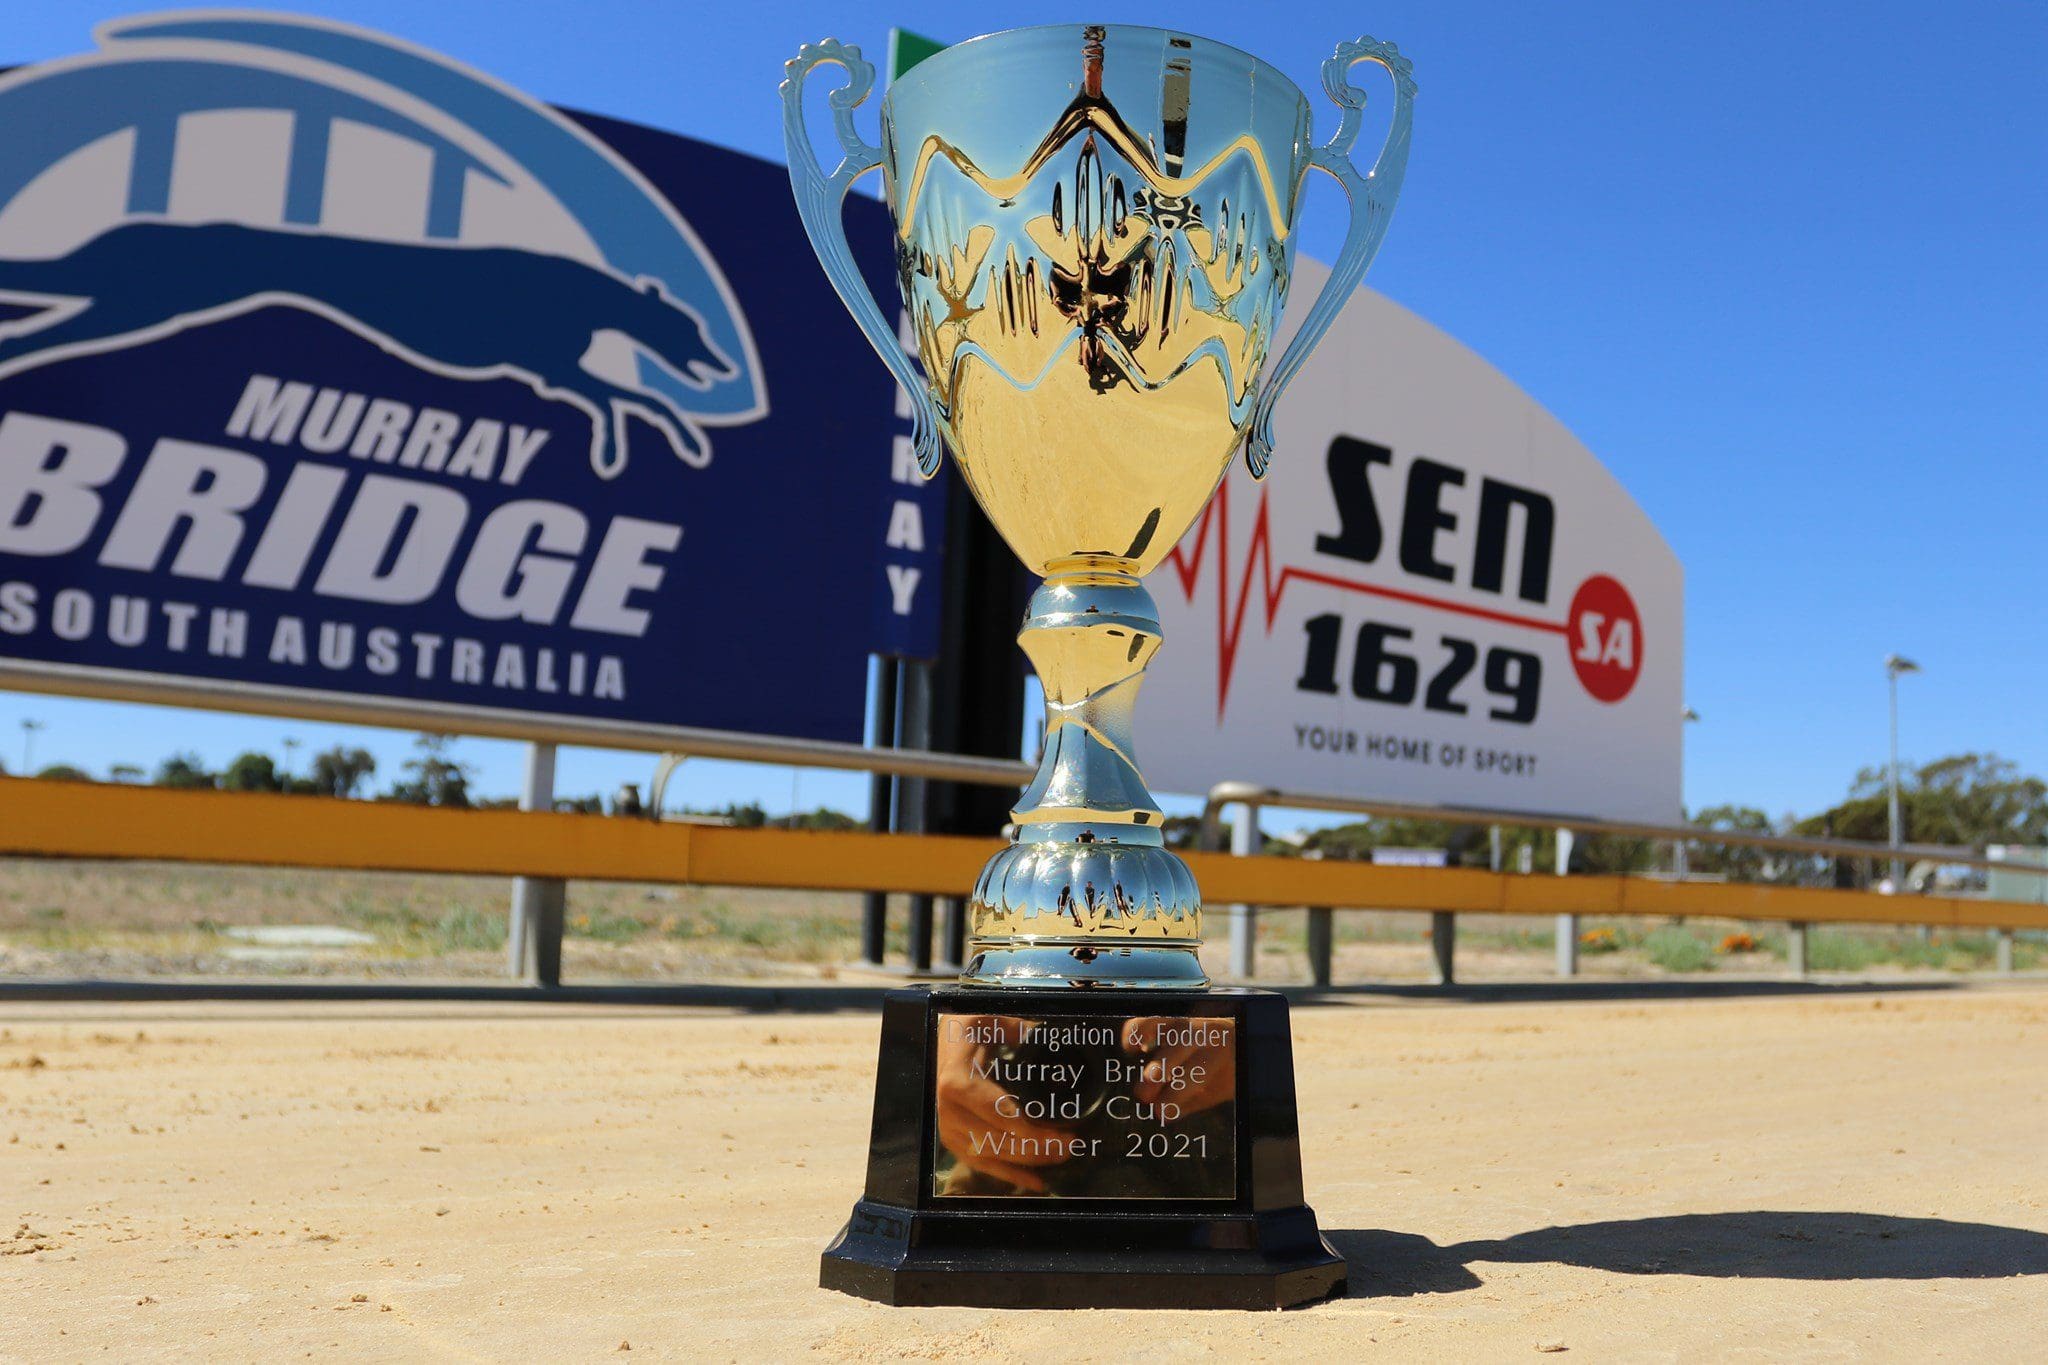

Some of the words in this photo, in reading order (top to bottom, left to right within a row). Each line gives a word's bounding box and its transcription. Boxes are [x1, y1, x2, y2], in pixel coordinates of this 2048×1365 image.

[225, 374, 549, 485] MURRAY
[0, 411, 683, 637] BRIDGE
[1313, 433, 1555, 606] SEN
[0, 580, 249, 658] SOUTH
[268, 615, 627, 700] AUSTRALIA
[1296, 613, 1543, 726] 1629
[1575, 611, 1634, 671] SA
[1294, 724, 1358, 755] YOUR
[1366, 732, 1432, 765] HOME
[1439, 743, 1467, 768] OF
[1474, 748, 1538, 777] SPORT
[1018, 1020, 1115, 1052] Irrigation
[1128, 1026, 1144, 1046] &
[1156, 1021, 1230, 1047] Fodder
[968, 1057, 1085, 1089] Murray
[1105, 1058, 1207, 1090] Bridge
[994, 1093, 1081, 1119] Gold
[1106, 1095, 1181, 1127] Cup
[968, 1130, 1102, 1157] Winner
[1125, 1133, 1208, 1158] 2021
